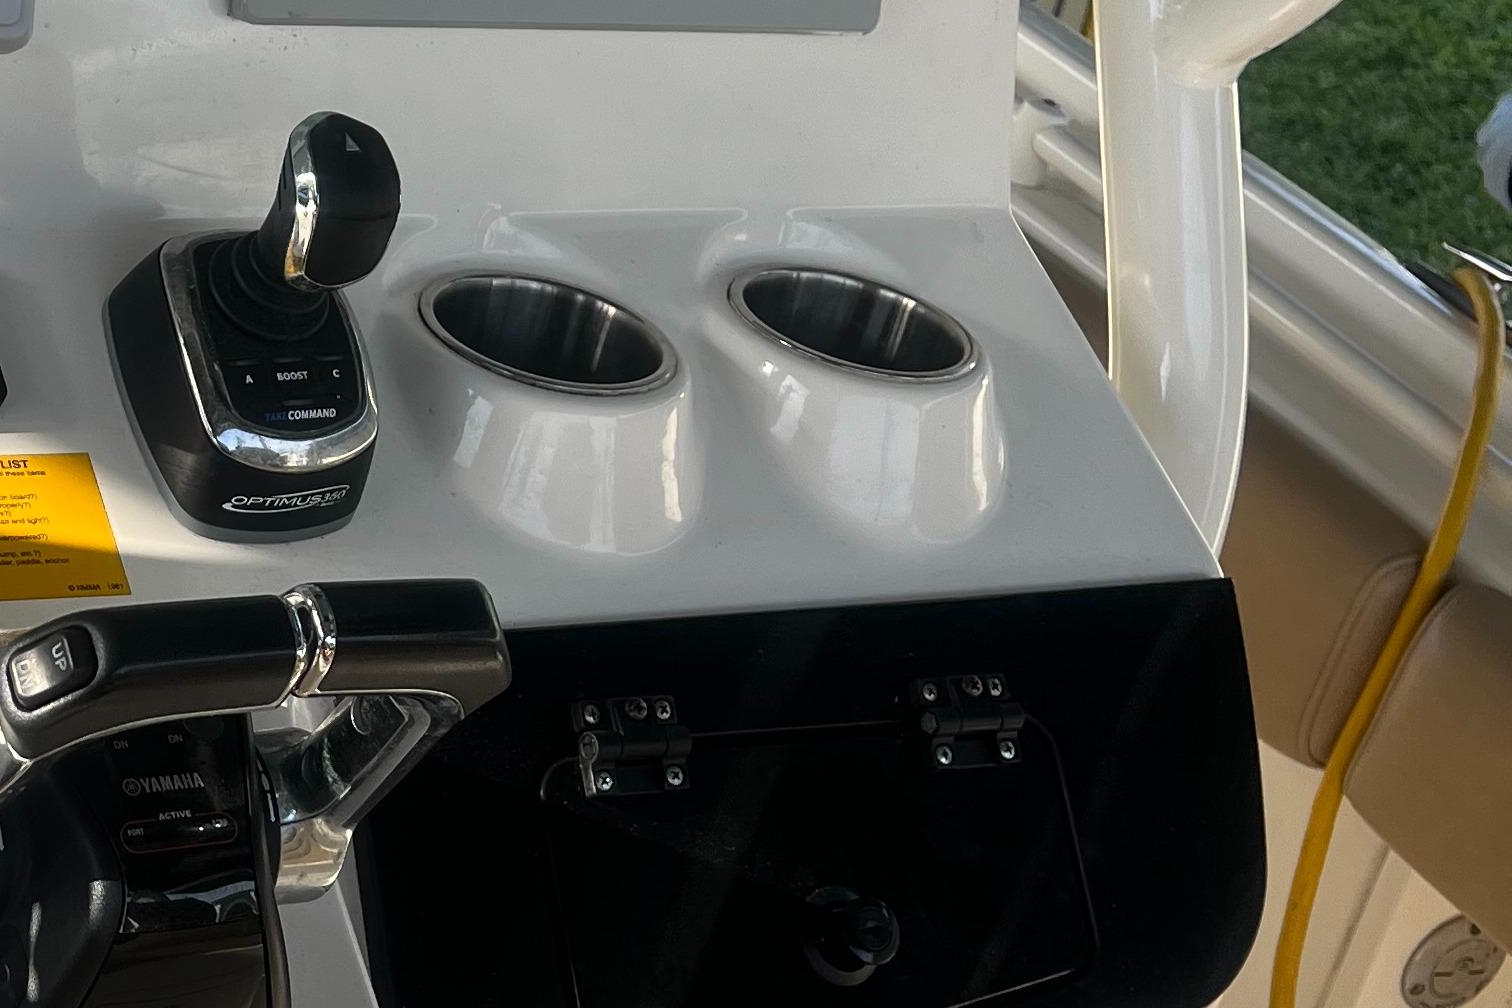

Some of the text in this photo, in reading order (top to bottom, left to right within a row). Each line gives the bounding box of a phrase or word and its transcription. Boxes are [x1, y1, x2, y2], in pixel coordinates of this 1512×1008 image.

[277, 371, 308, 382] BOOST
[332, 368, 341, 378] C
[245, 374, 254, 385] A
[288, 408, 337, 420] COMMAND
[0, 459, 29, 469] LIST
[52, 642, 67, 671] UP
[113, 740, 128, 749] DN
[140, 772, 205, 792] YAMAHA
[158, 810, 192, 821] ACTIVE
